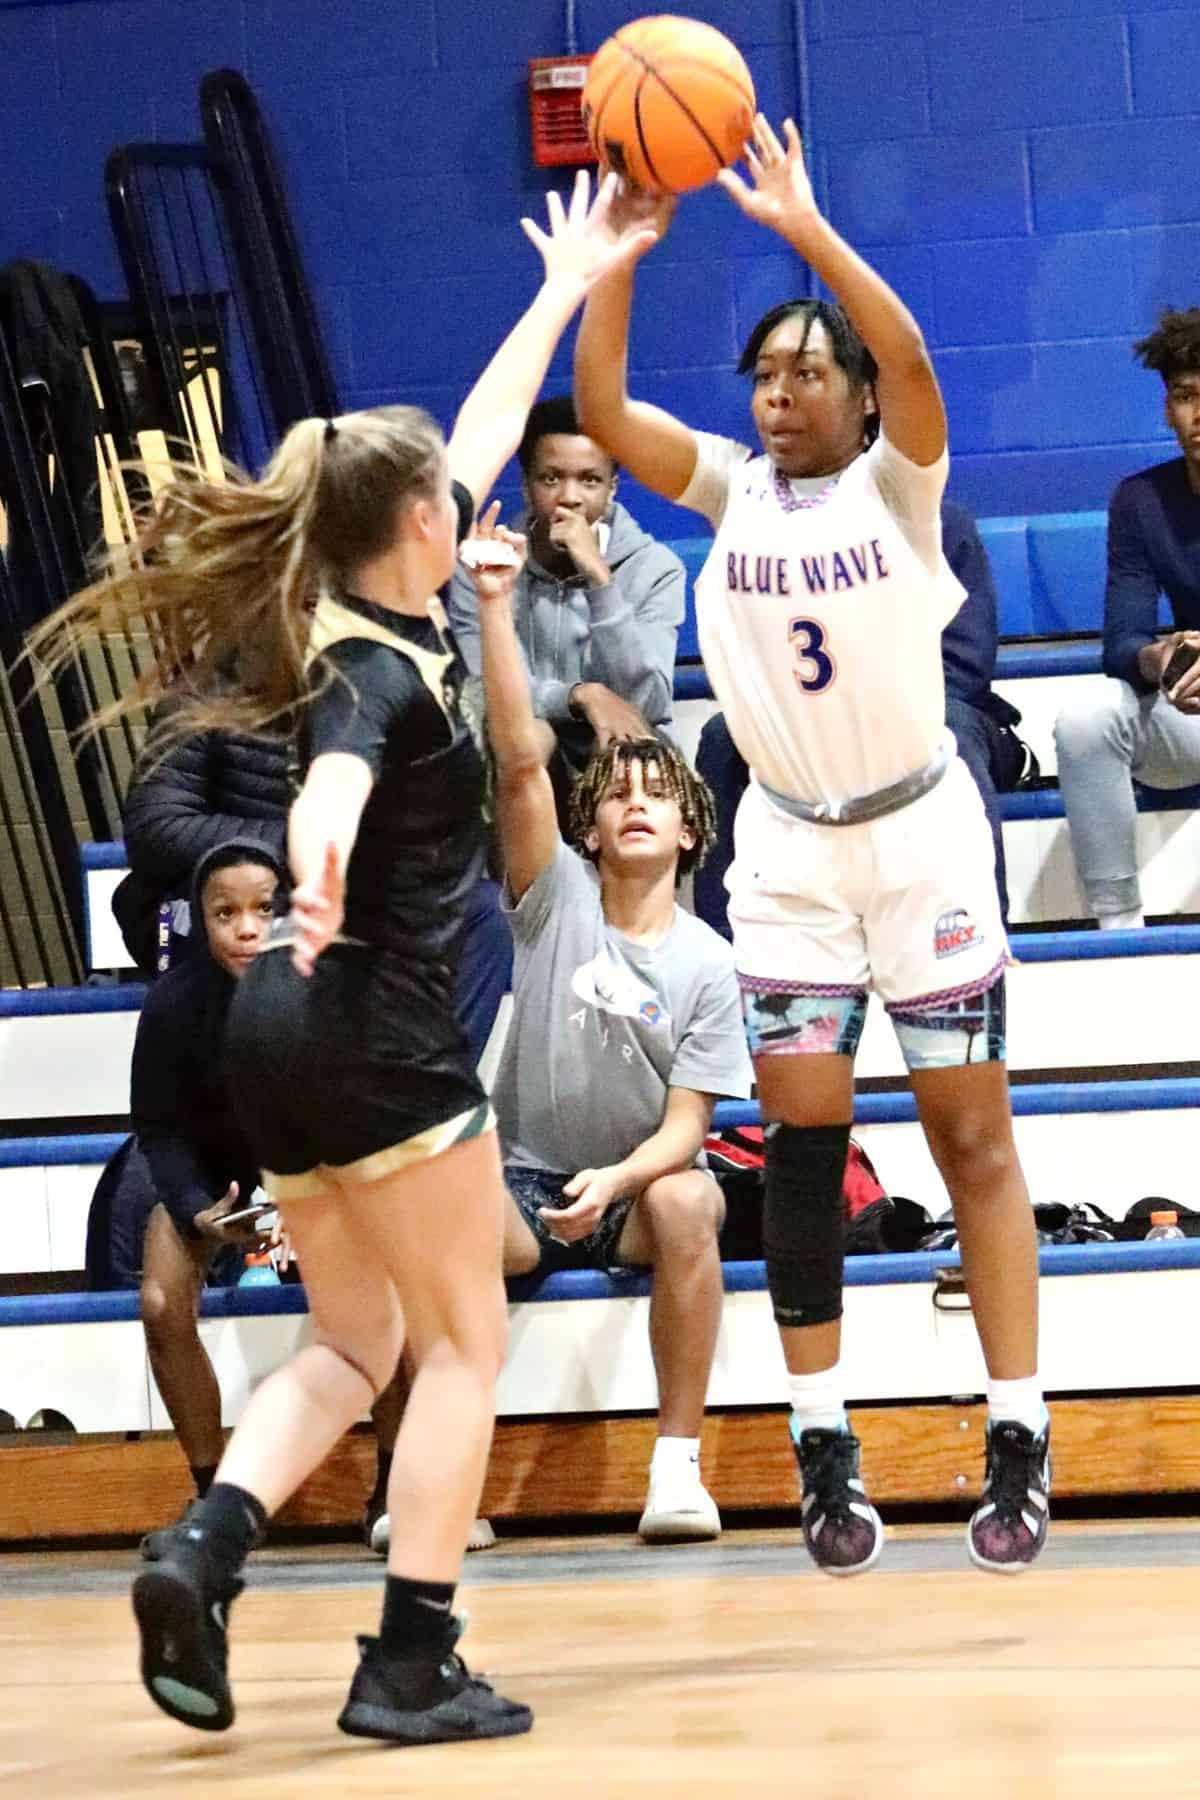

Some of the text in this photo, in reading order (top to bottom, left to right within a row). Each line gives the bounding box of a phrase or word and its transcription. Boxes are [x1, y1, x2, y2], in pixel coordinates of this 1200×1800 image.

[727, 539, 888, 596] BLUE WAVE
[788, 615, 838, 696] 3
[567, 1007, 634, 1064] AIR
